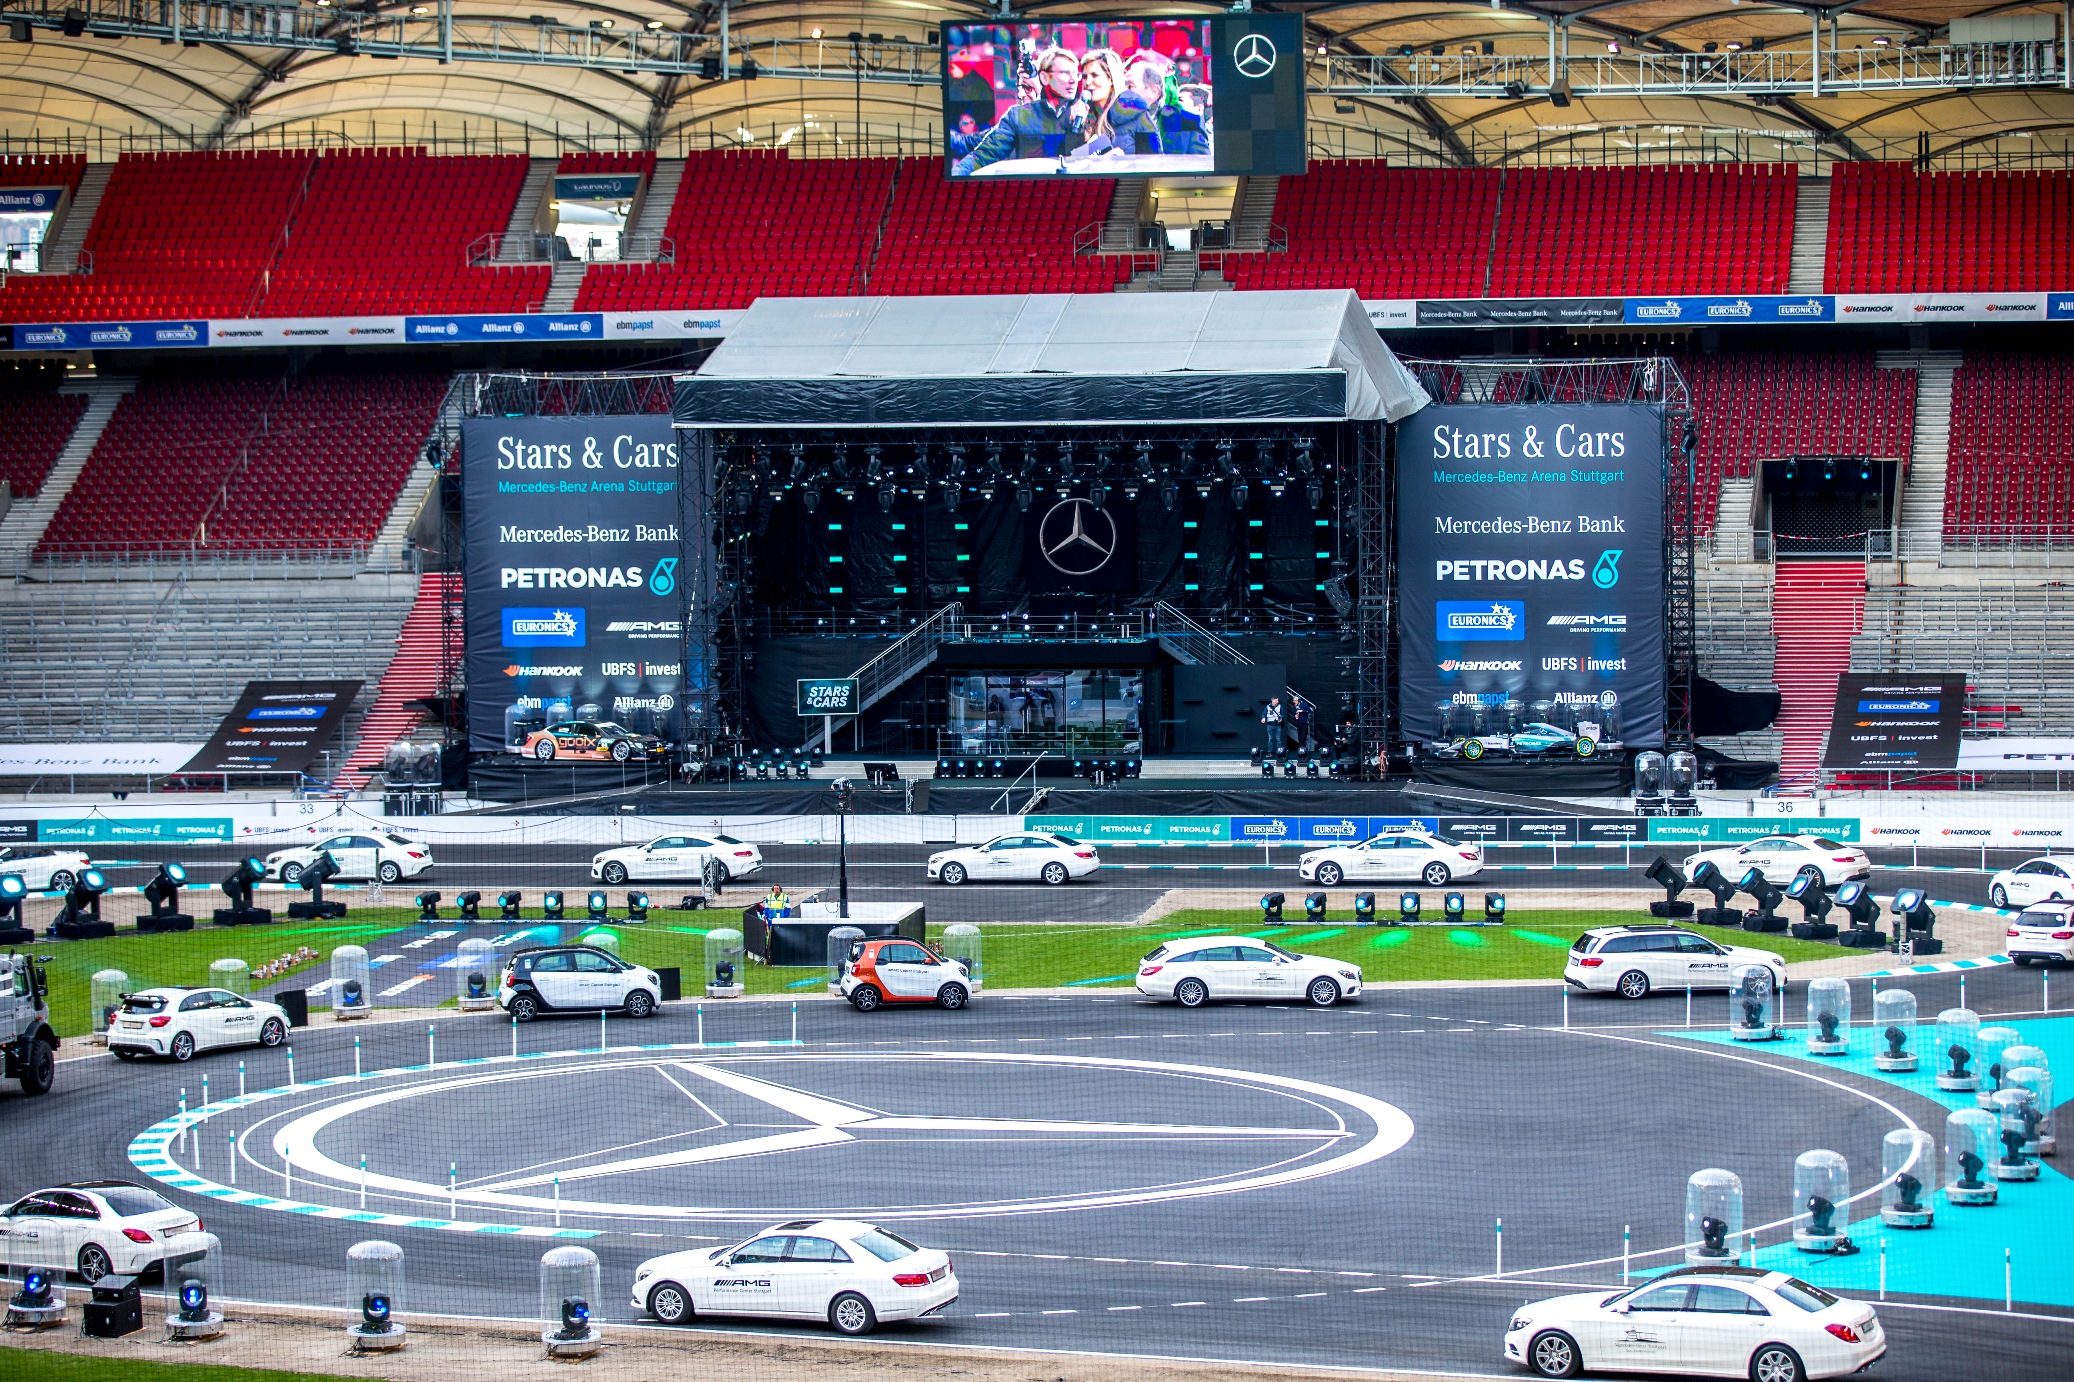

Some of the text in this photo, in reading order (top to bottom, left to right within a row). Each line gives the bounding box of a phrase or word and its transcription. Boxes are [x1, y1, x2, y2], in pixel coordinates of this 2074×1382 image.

[0, 195, 31, 204] Allianz
[416, 324, 446, 334] Allianz
[482, 324, 512, 333] Allianz
[549, 322, 579, 332] Allianz
[616, 320, 654, 331] ebmpapst
[683, 319, 721, 330] ebmpapst
[28, 334, 62, 342] EURONICS
[93, 332, 128, 340] EURONICS
[158, 331, 194, 339] EURONICS
[1433, 423, 1625, 459] Stars & Cars
[498, 435, 679, 470] Stars & Cars
[1433, 469, 1624, 485] Mercedes-Benz Arena Stuttgart
[498, 481, 587, 493] Mercedes-Benz
[590, 481, 625, 492] Arena
[1435, 515, 1625, 534] Mercedes-Benz Bank
[500, 524, 679, 542] Mercedes-Benz Bank
[1436, 559, 1586, 581] PETRONAS
[501, 566, 643, 588] PETRONAS
[1452, 616, 1507, 626] EURONICS
[1571, 615, 1626, 624] AMG
[516, 622, 569, 632] EURONICS
[602, 662, 680, 676] UBFS invest
[1542, 657, 1626, 670] UBFS invest
[810, 686, 850, 697] STARS
[613, 697, 656, 709] Allianz
[1554, 692, 1598, 704] Allianz
[300, 804, 314, 814] 33
[1777, 802, 1794, 813] 36
